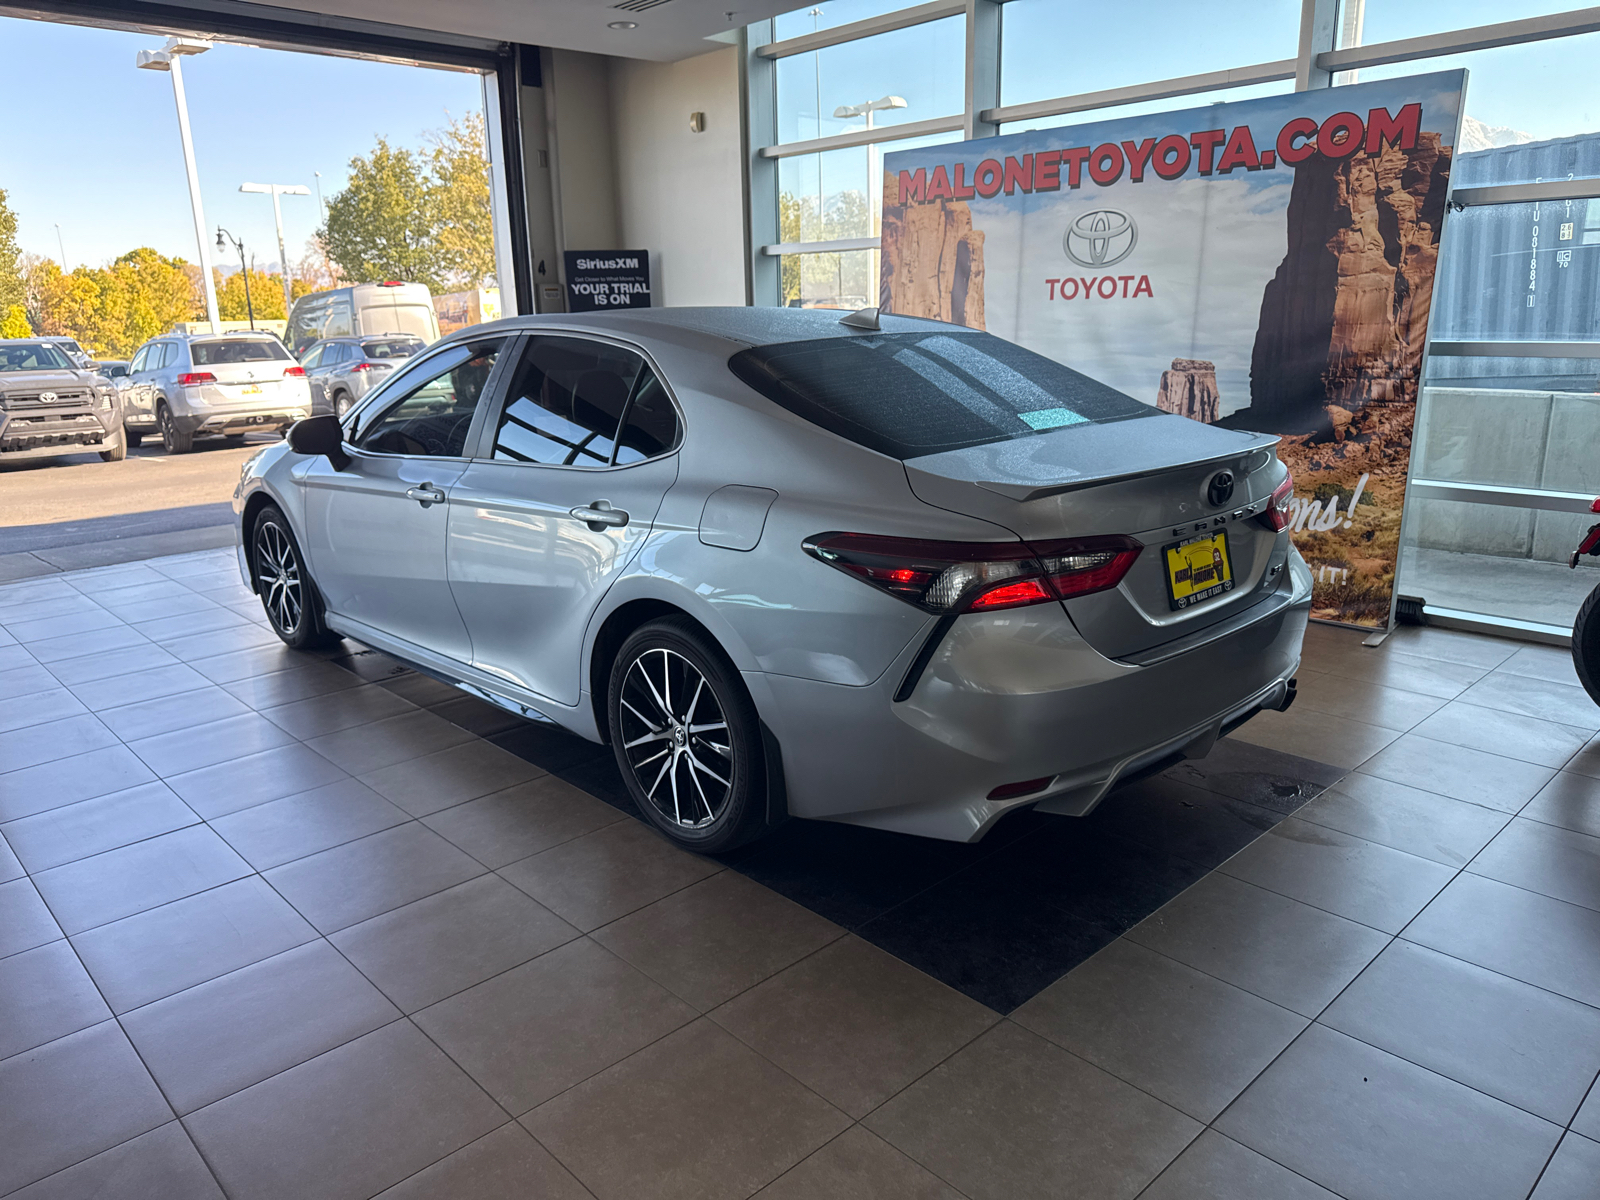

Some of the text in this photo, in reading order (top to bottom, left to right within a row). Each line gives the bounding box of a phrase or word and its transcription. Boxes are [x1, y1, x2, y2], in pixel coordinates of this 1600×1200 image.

[899, 103, 1422, 206] MALONETOYOTA.COM
[538, 259, 546, 277] 4
[576, 258, 639, 269] SiriusXM
[571, 283, 609, 295] YOUR
[611, 282, 650, 293] TRIAL
[1045, 275, 1154, 301] TOYOTA
[594, 294, 630, 305] IS ON
[1214, 552, 1221, 561] 32
[1319, 566, 1348, 585] IT!
[1197, 590, 1208, 601] MAKE
[1212, 585, 1223, 595] EASY
